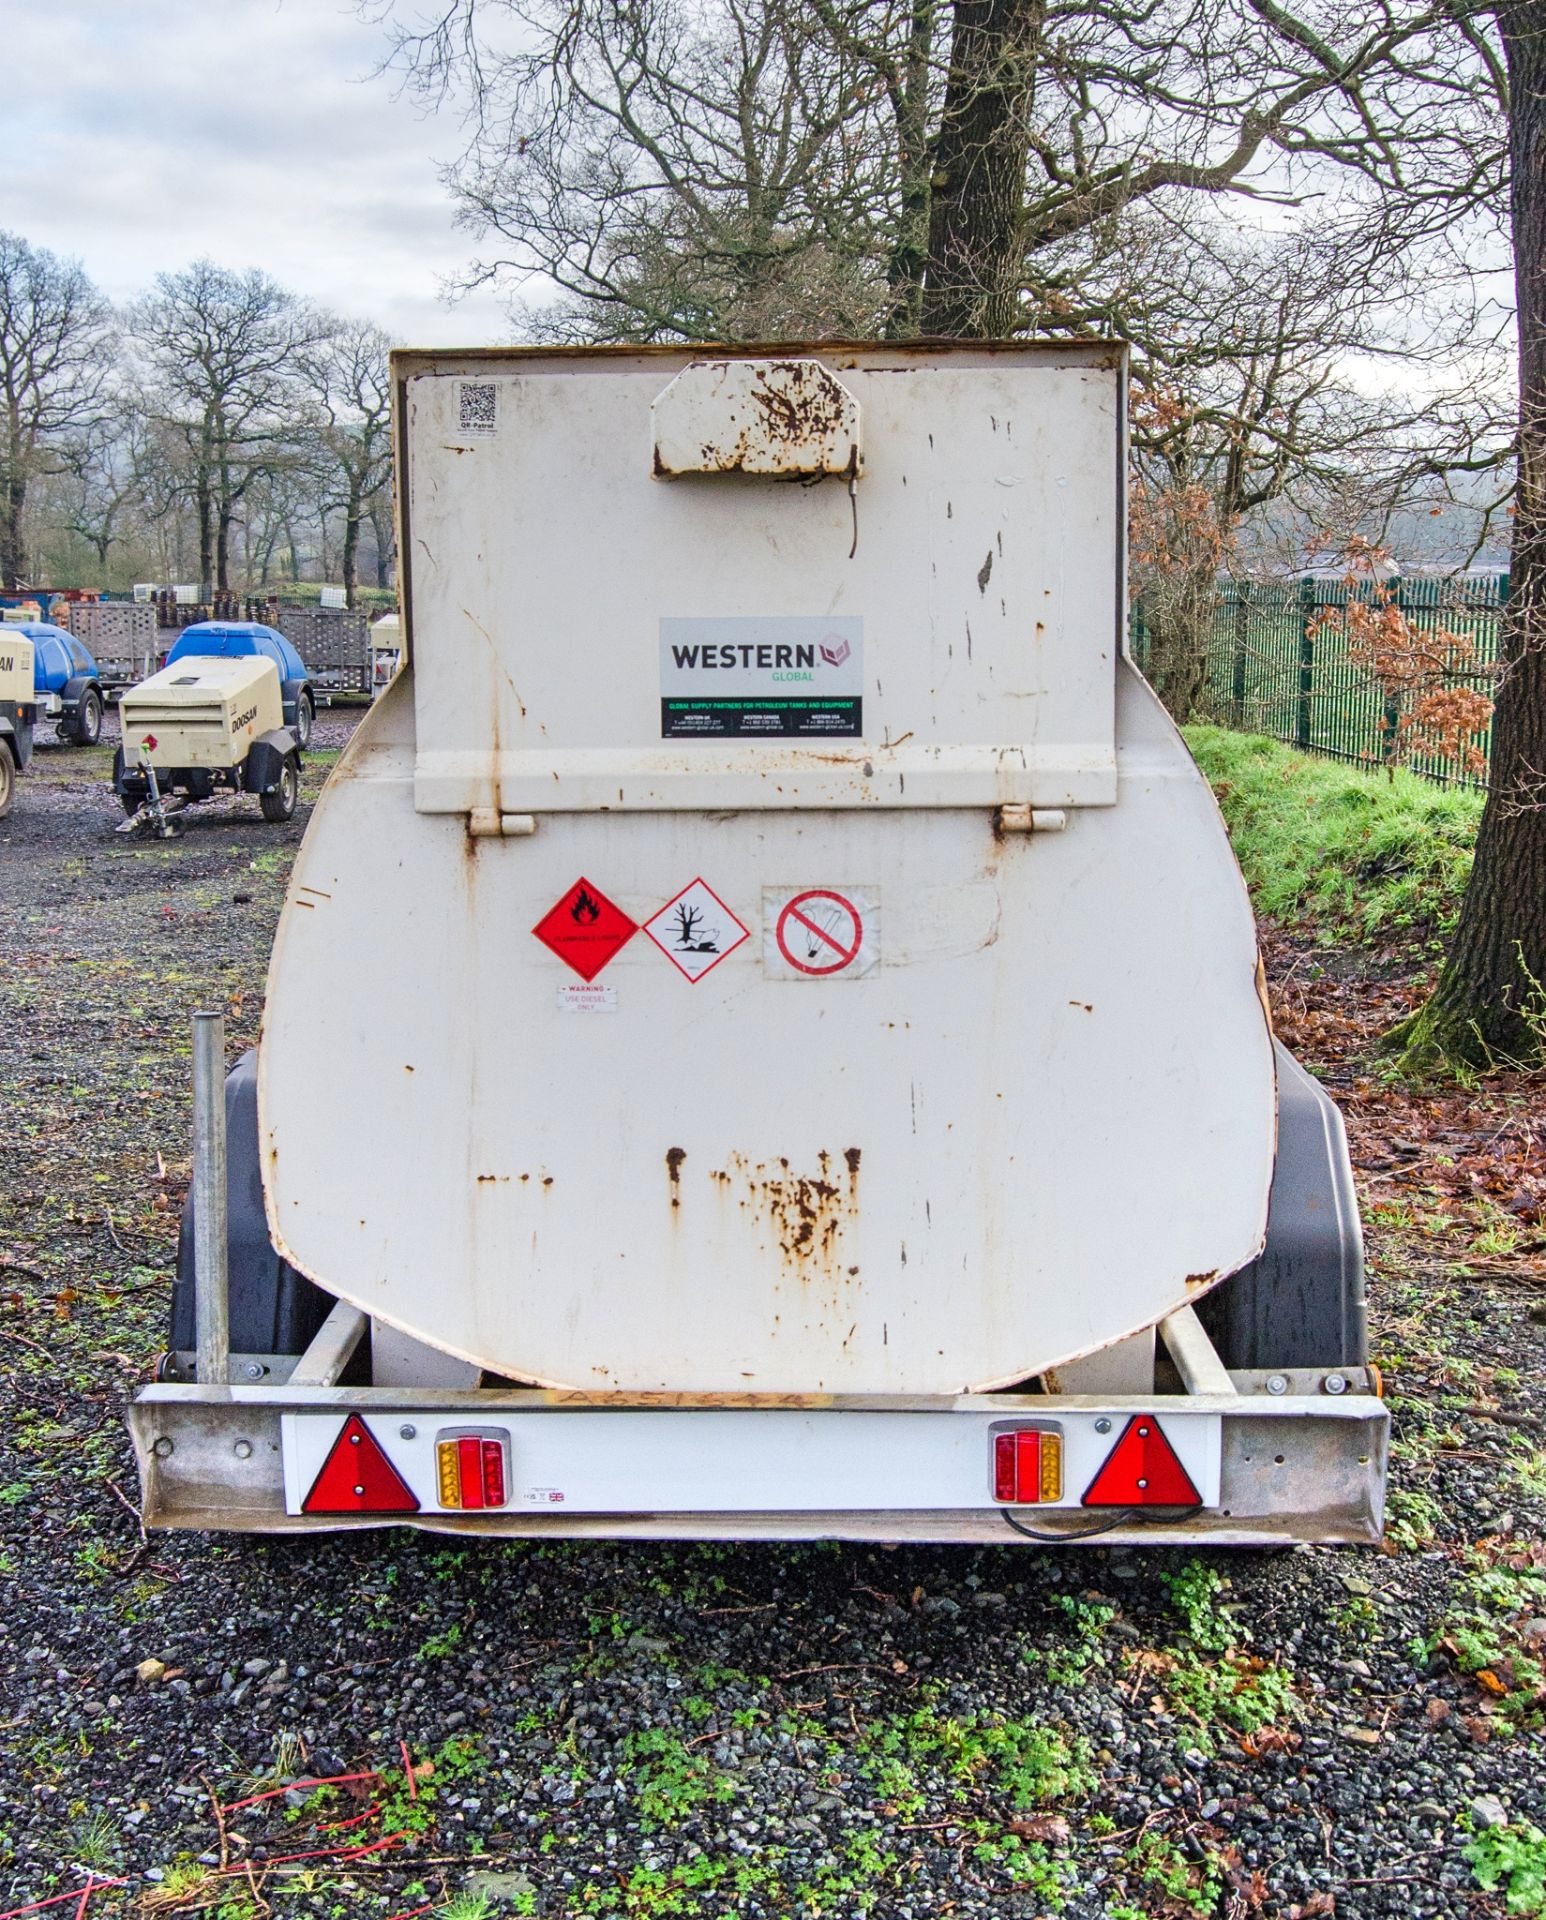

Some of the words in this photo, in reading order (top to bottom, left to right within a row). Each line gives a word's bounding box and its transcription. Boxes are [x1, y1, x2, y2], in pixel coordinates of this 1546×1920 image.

[672, 644, 815, 669] WESTERN
[772, 671, 815, 682] GLOBAL
[232, 705, 257, 734] DOOSAN
